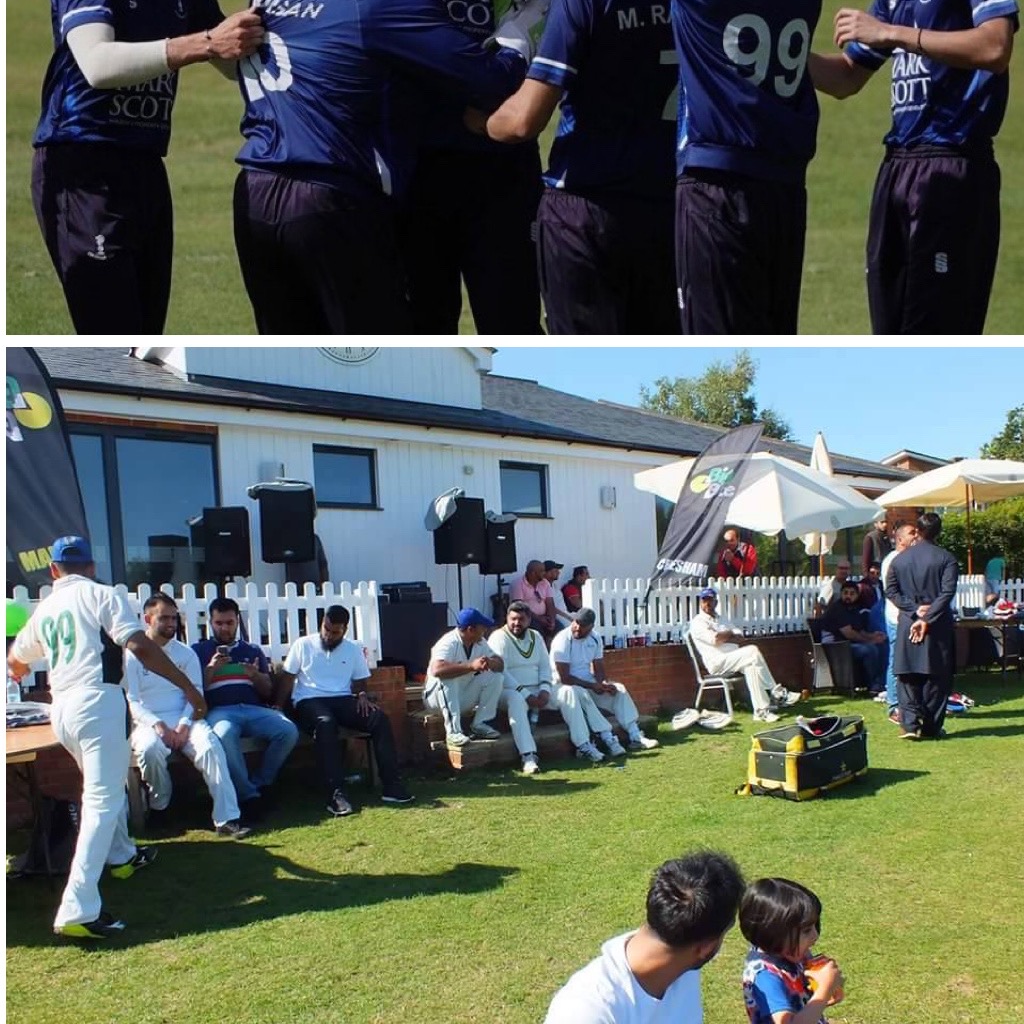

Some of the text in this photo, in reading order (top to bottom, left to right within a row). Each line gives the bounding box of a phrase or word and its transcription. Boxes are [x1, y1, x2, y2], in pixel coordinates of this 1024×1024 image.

[722, 13, 811, 98] 99
[891, 77, 931, 107] OTT
[108, 93, 173, 121] SCOT
[18, 545, 54, 572] MA
